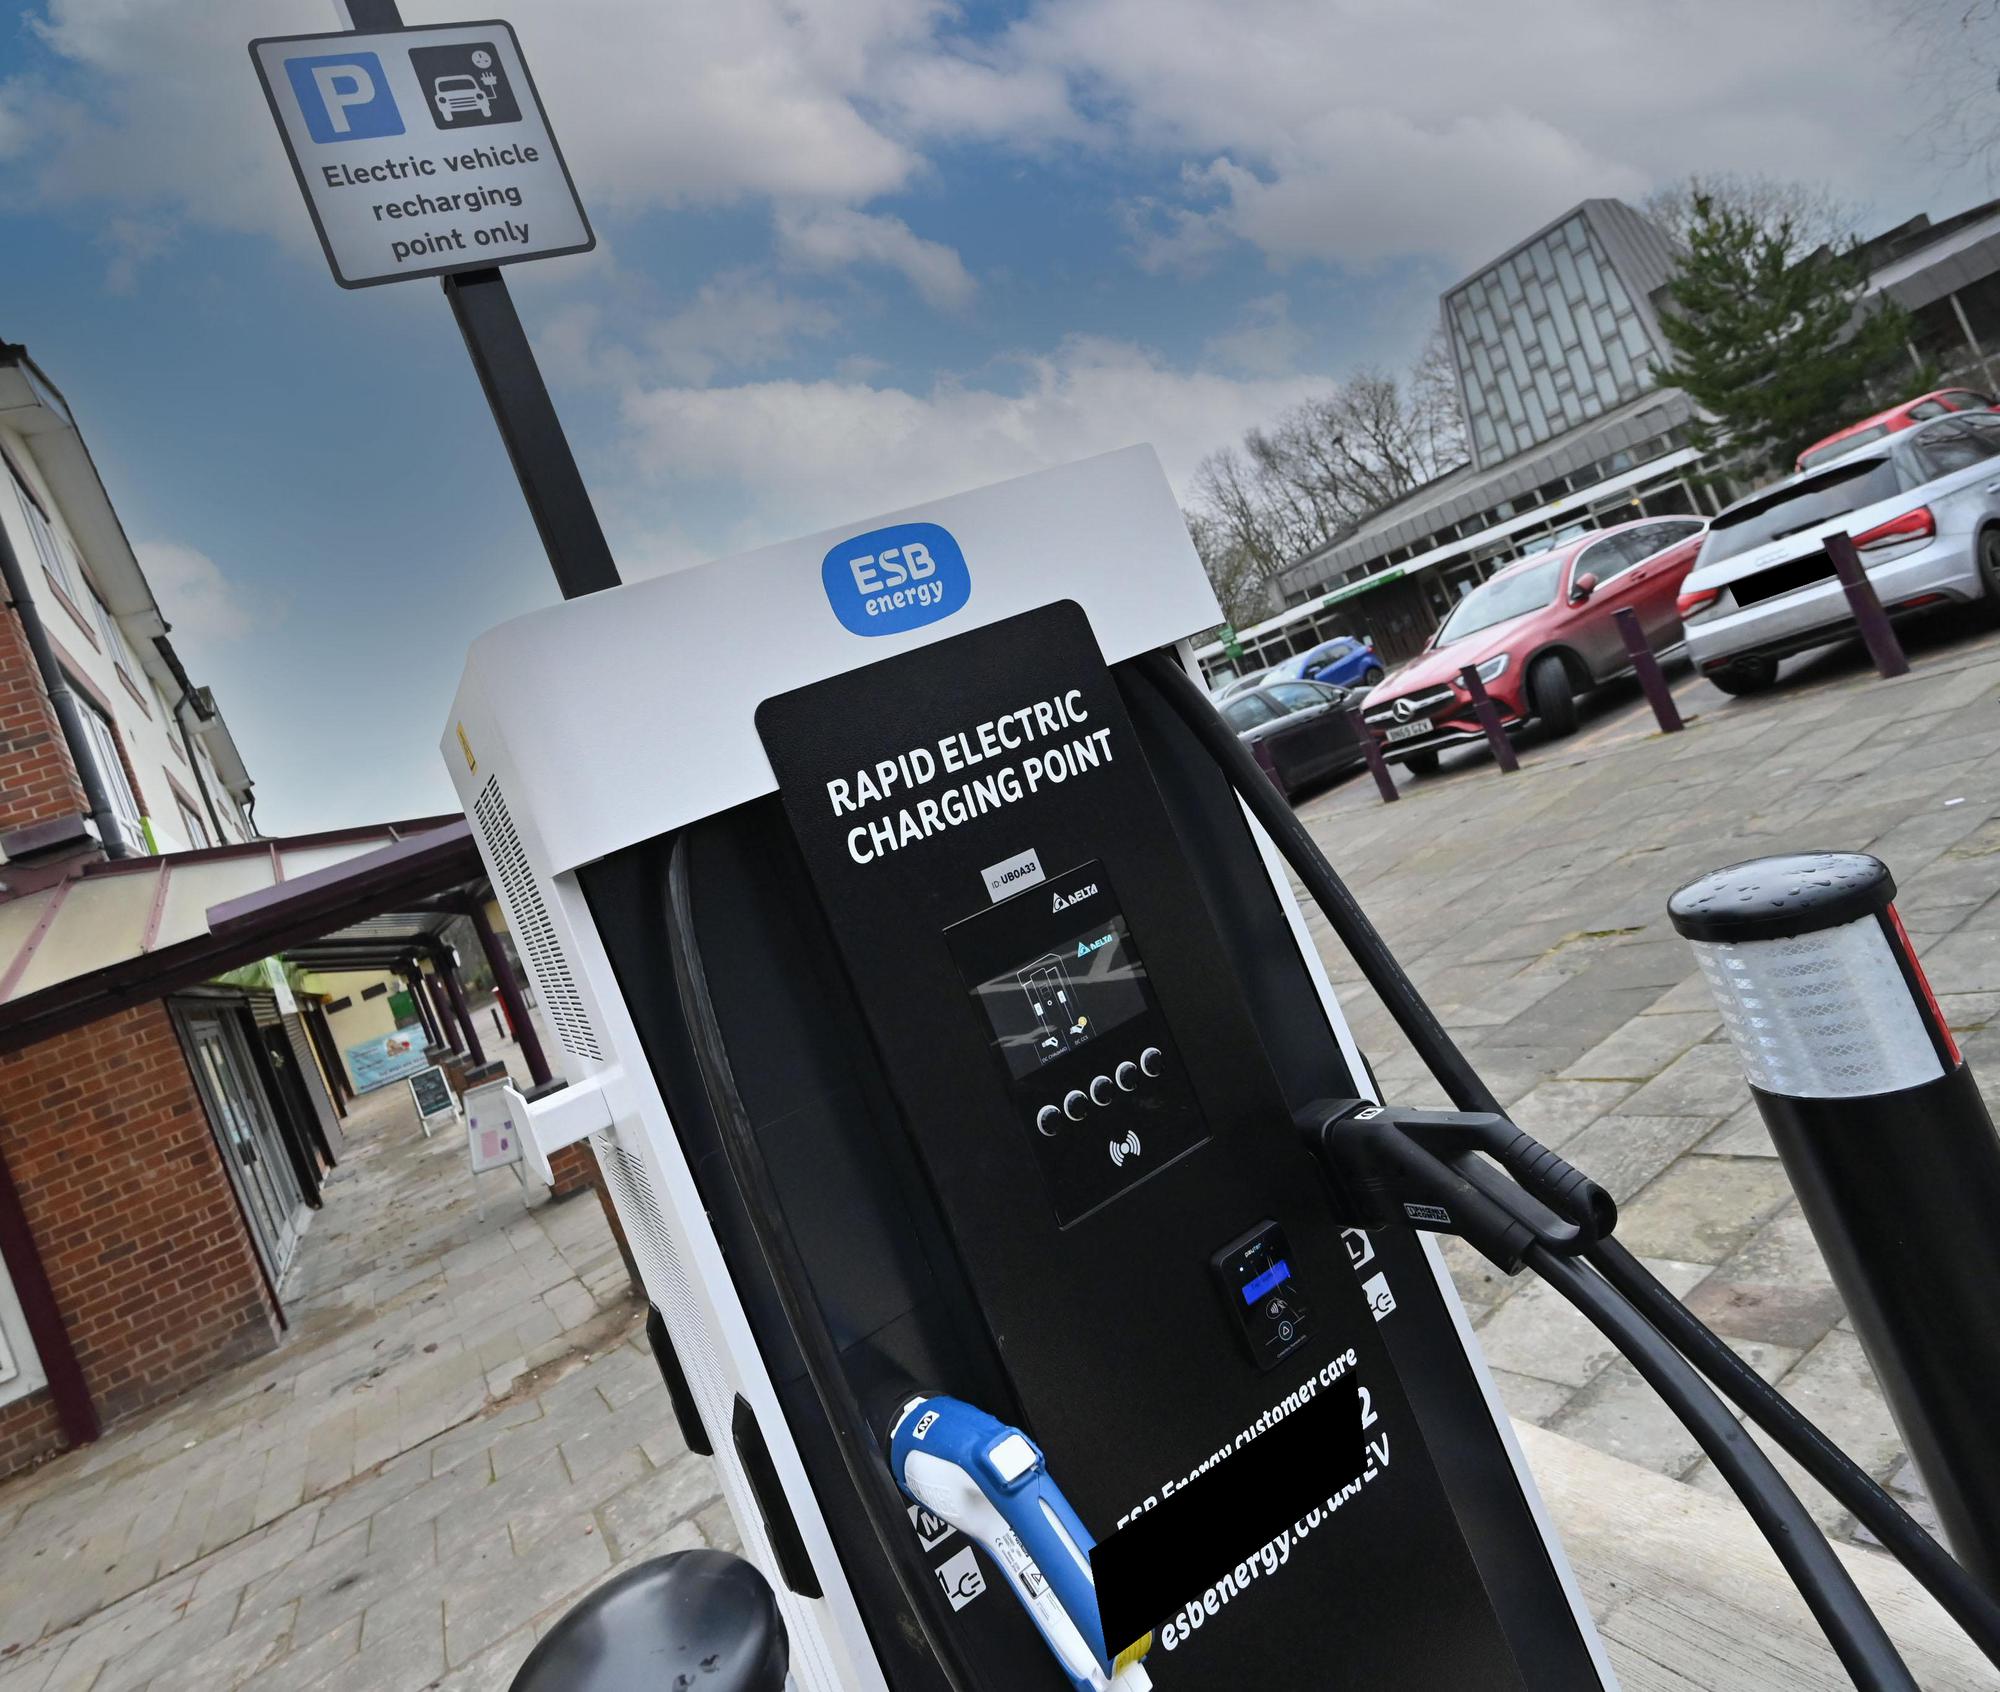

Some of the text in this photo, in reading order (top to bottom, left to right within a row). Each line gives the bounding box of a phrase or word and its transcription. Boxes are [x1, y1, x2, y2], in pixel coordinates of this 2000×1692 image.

[311, 64, 376, 133] P
[321, 143, 539, 188] Electric vehicle
[372, 184, 523, 221] recharging
[391, 220, 530, 262] point only
[849, 542, 936, 596] ESB
[865, 579, 944, 616] energy
[826, 689, 1089, 817] RAPID ELECTRIC
[847, 728, 1114, 865] CHARGING POINT
[991, 878, 1001, 889] ID:
[1068, 883, 1098, 905] DELTA
[1089, 934, 1112, 951] DELTA
[1235, 1376, 1317, 1450] customer
[1319, 1347, 1358, 1387] care
